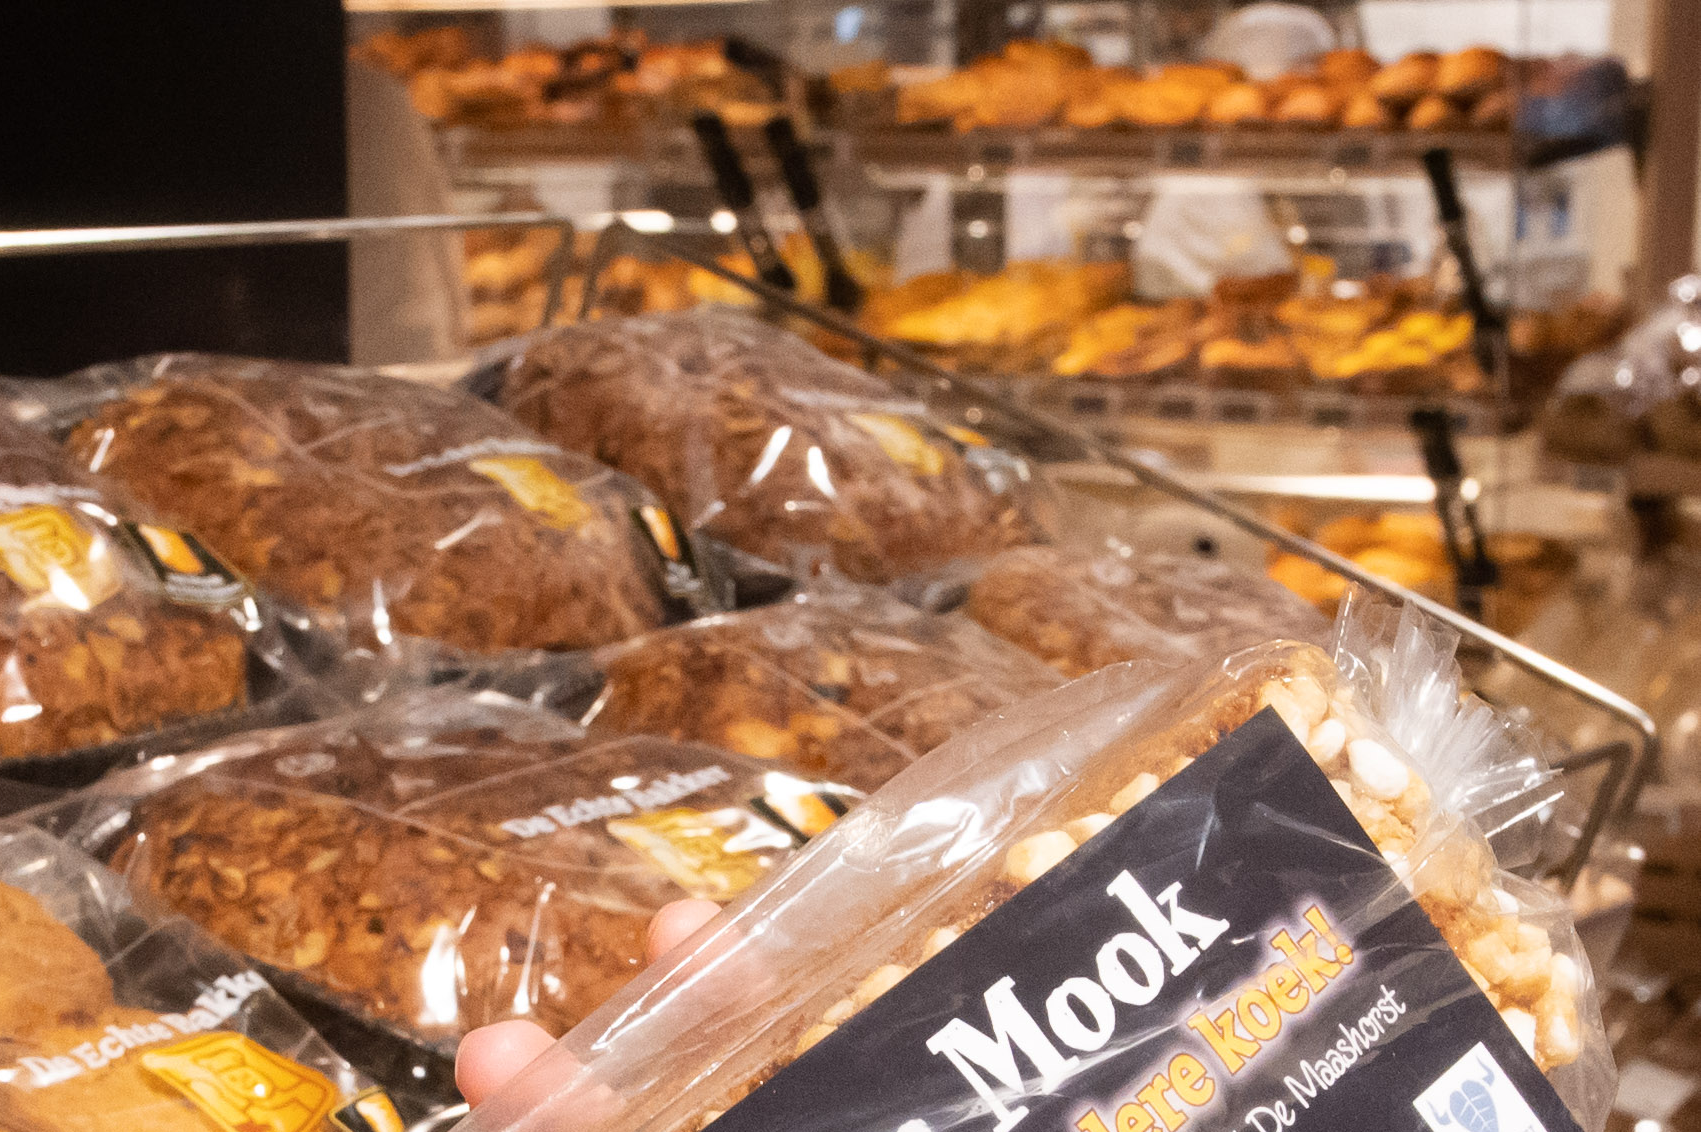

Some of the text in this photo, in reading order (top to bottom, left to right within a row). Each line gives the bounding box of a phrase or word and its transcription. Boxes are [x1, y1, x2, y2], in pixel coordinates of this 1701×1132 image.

[71, 1012, 174, 1071] Echte
[1187, 903, 1354, 1076] koek!
[1283, 984, 1407, 1110] Maashorst
